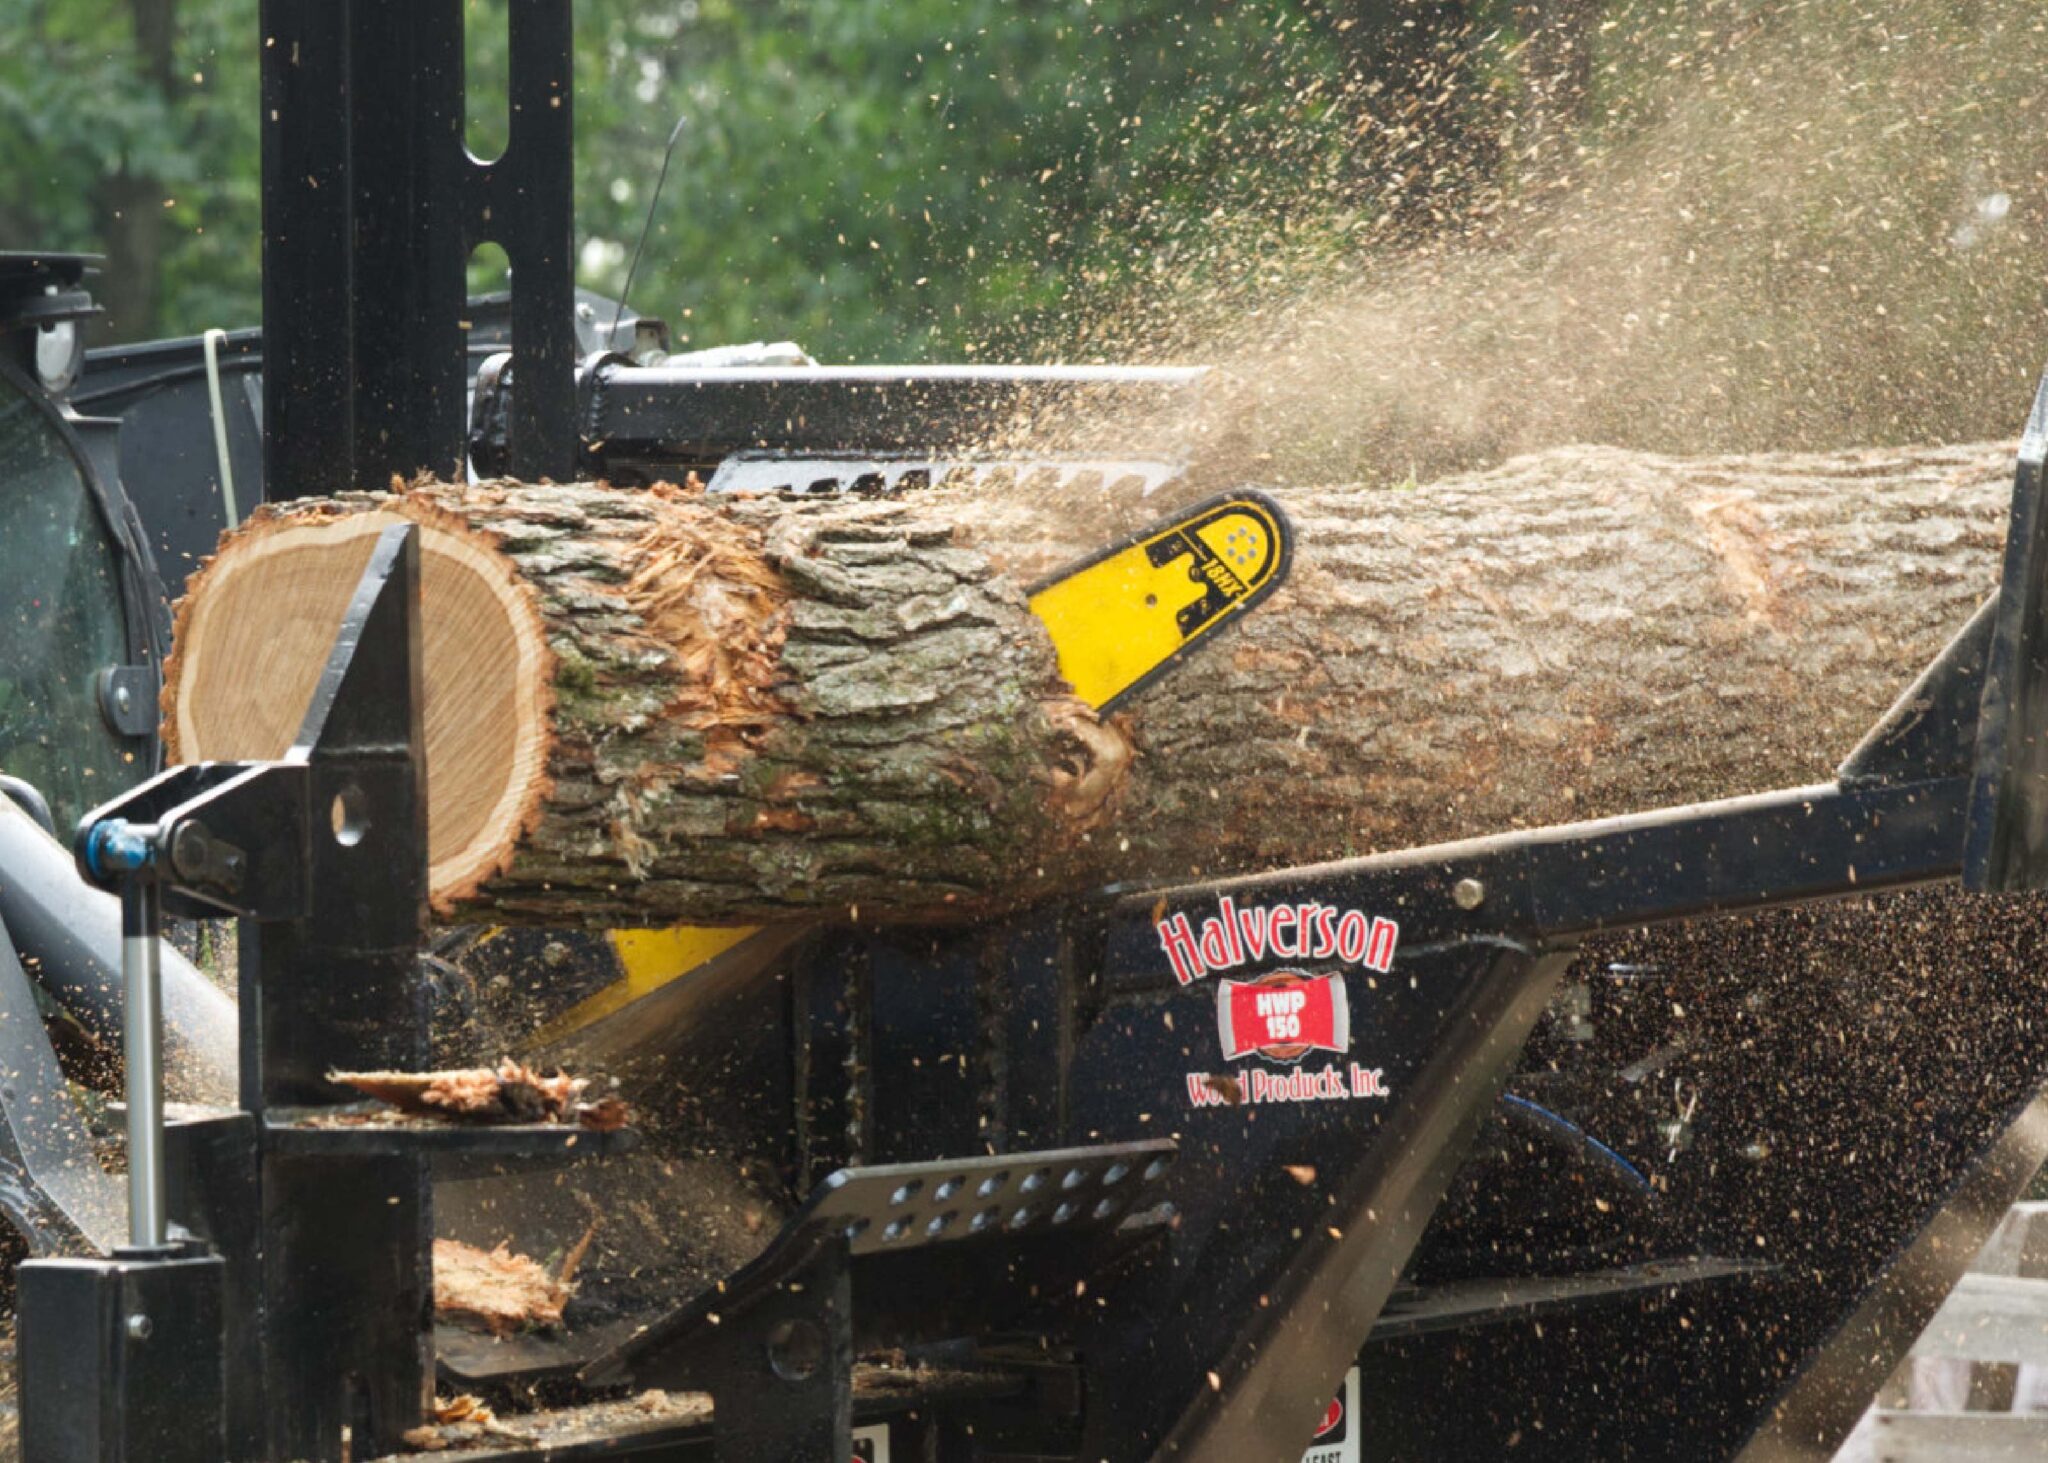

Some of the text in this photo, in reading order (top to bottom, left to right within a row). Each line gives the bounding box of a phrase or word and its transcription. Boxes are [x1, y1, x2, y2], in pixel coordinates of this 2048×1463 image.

[1157, 896, 1398, 985] Halverson
[1256, 990, 1306, 1017] HWP
[1266, 1014, 1300, 1039] 150
[1186, 1070, 1249, 1108] Wod
[1351, 1061, 1390, 1098] Inc.
